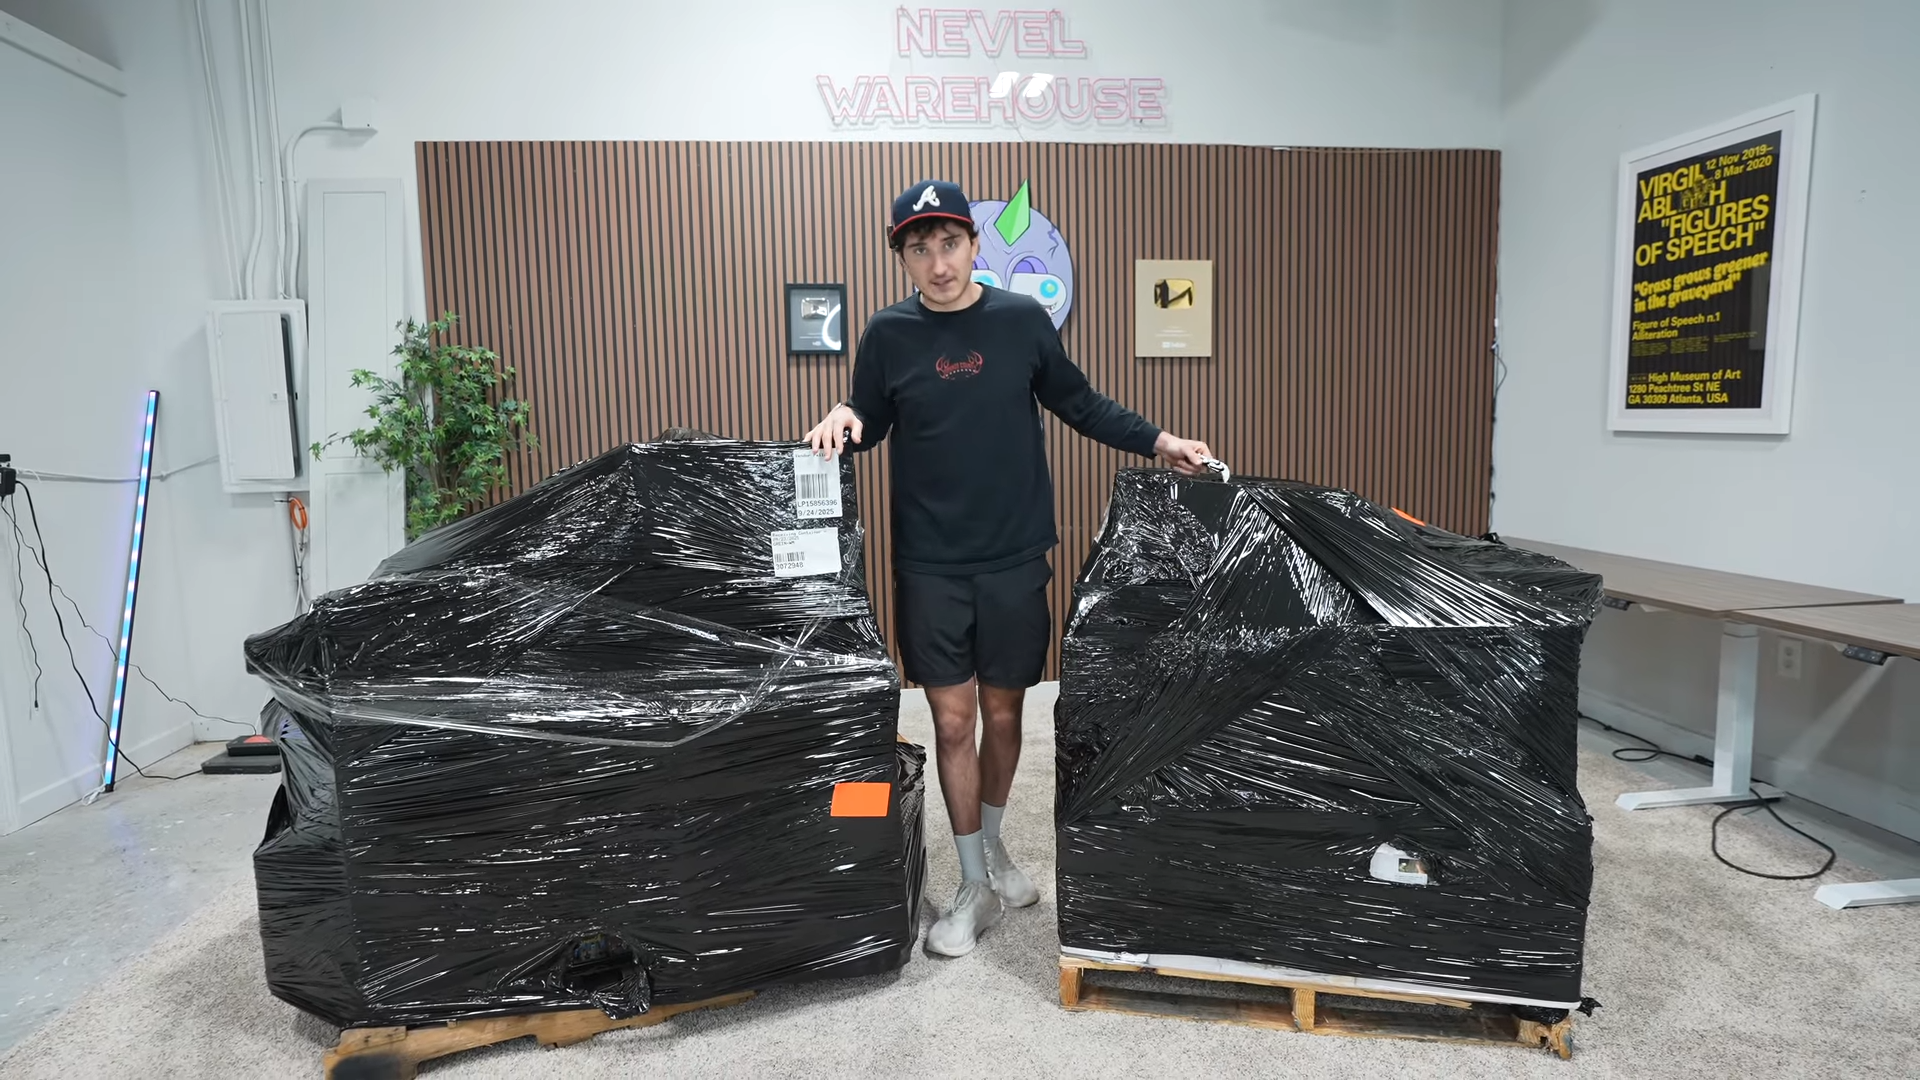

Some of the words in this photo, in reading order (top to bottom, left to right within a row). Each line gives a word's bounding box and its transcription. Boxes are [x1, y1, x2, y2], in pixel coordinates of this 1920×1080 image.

[896, 8, 1086, 57] NEVEL
[816, 75, 1167, 124] WAREHOUSE
[1705, 159, 1716, 170] 12
[1718, 154, 1740, 167] Nov
[1714, 168, 1722, 180] 8
[1723, 164, 1745, 177] Mar
[1746, 155, 1773, 171] 2020
[1639, 163, 1704, 200] VIRGIL
[1637, 180, 1727, 223] ABLH
[1661, 194, 1770, 239] "FIGURES
[1635, 241, 1664, 267] OF
[1665, 220, 1766, 261] SPEECH"
[1673, 266, 1712, 291] grows
[1713, 251, 1769, 281] greener
[1634, 298, 1646, 313] in
[1647, 293, 1667, 310] the
[1633, 319, 1658, 332] Figure
[1660, 317, 1670, 328] of
[1671, 313, 1705, 328] Speech
[1707, 312, 1720, 322] n.1
[1632, 328, 1679, 341] Alliteration
[1648, 372, 1668, 384] High
[1670, 371, 1710, 382] Museum
[1712, 369, 1723, 380] of
[1724, 369, 1742, 380] Art
[1629, 384, 1647, 394] 1280
[1648, 382, 1691, 393] Peachtree
[1693, 382, 1704, 392] St
[1706, 381, 1720, 391] NE
[1628, 395, 1641, 404] GA
[1642, 394, 1668, 404] 30309
[1669, 394, 1704, 404] Atlanta,
[1706, 392, 1729, 403] USA
[797, 499, 838, 508] LP15856396
[798, 508, 835, 516] 9/24/2025
[775, 561, 804, 570] 3072948
